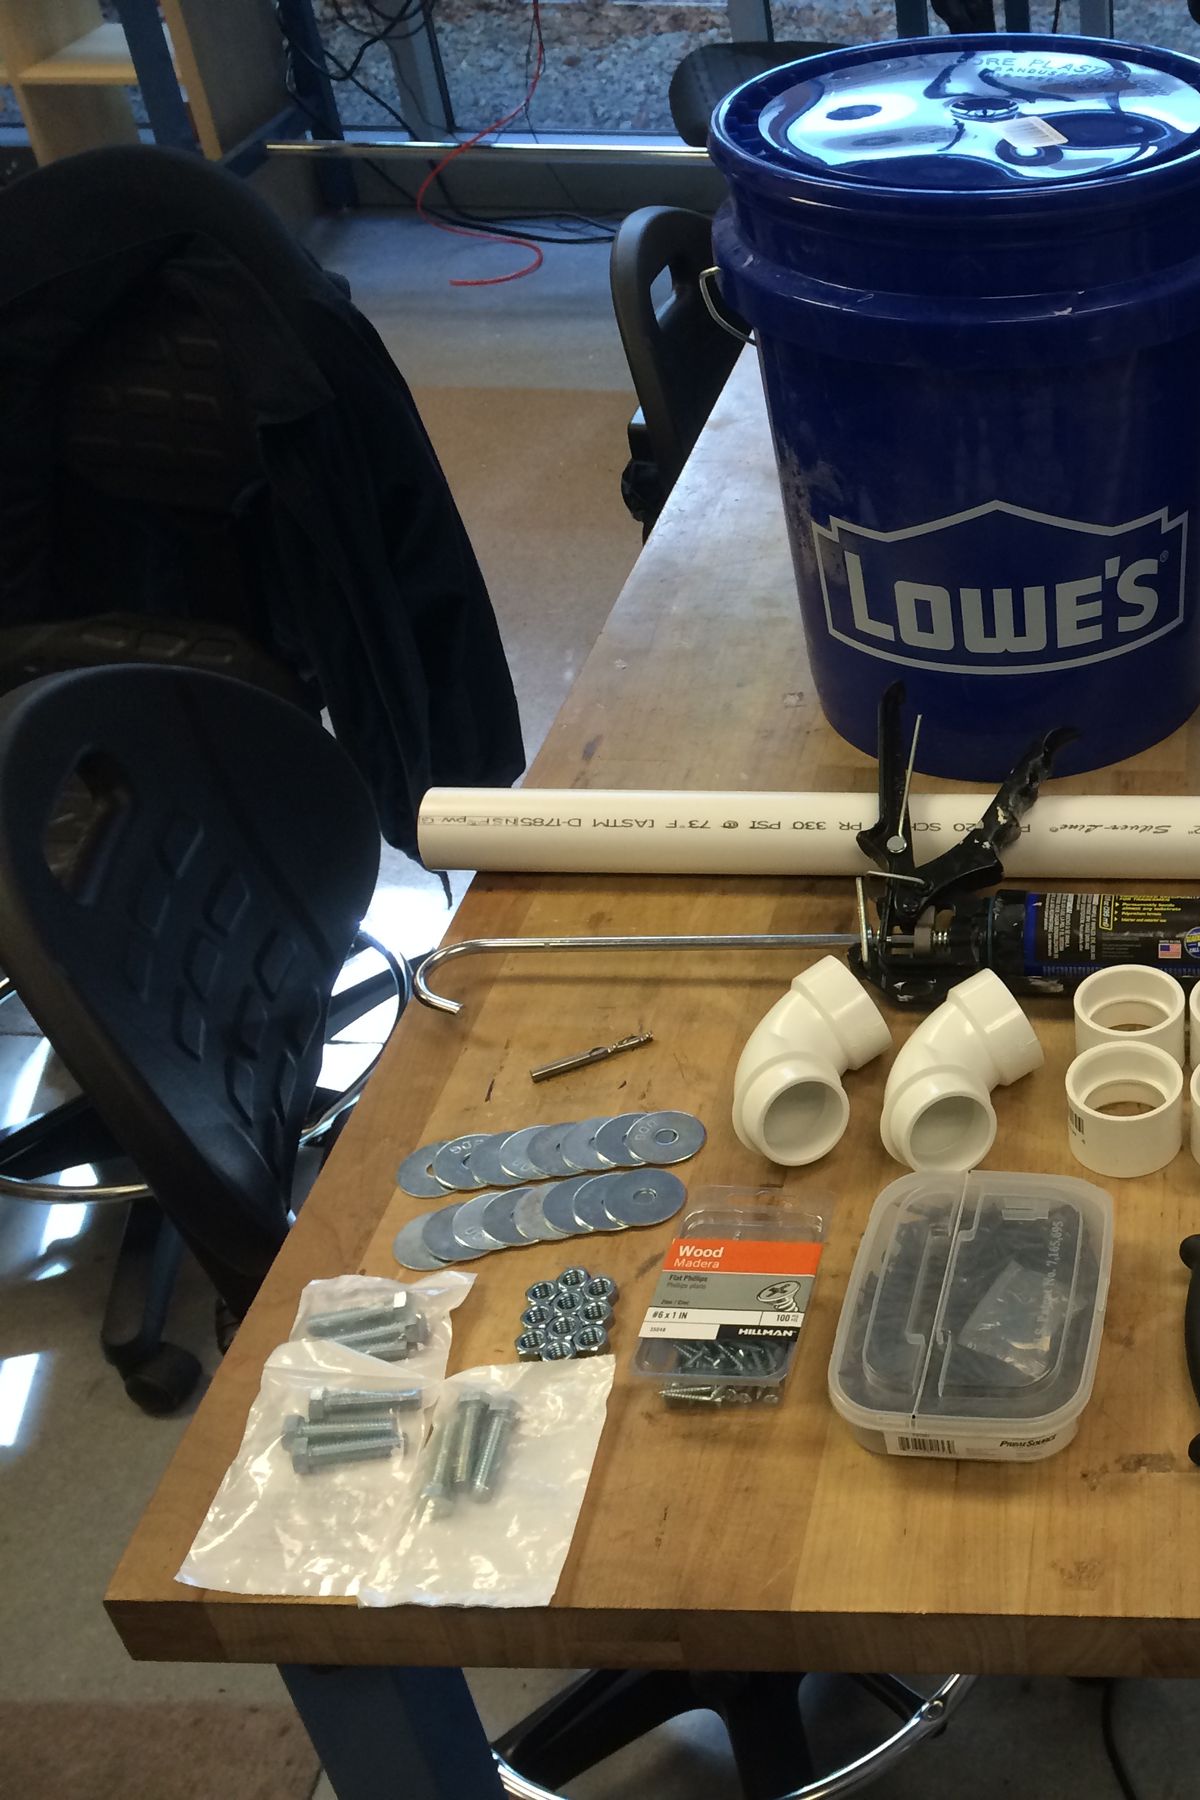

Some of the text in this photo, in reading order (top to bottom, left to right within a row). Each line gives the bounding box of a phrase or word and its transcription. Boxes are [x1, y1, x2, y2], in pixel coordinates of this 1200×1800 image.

[844, 550, 1159, 653] LOWE'S
[749, 820, 781, 830] PSI
[792, 821, 827, 830] 330
[679, 1245, 724, 1257] Wood
[674, 1258, 719, 1268] Madera
[776, 1314, 790, 1322] 100
[738, 1328, 793, 1337] HILLMAN
